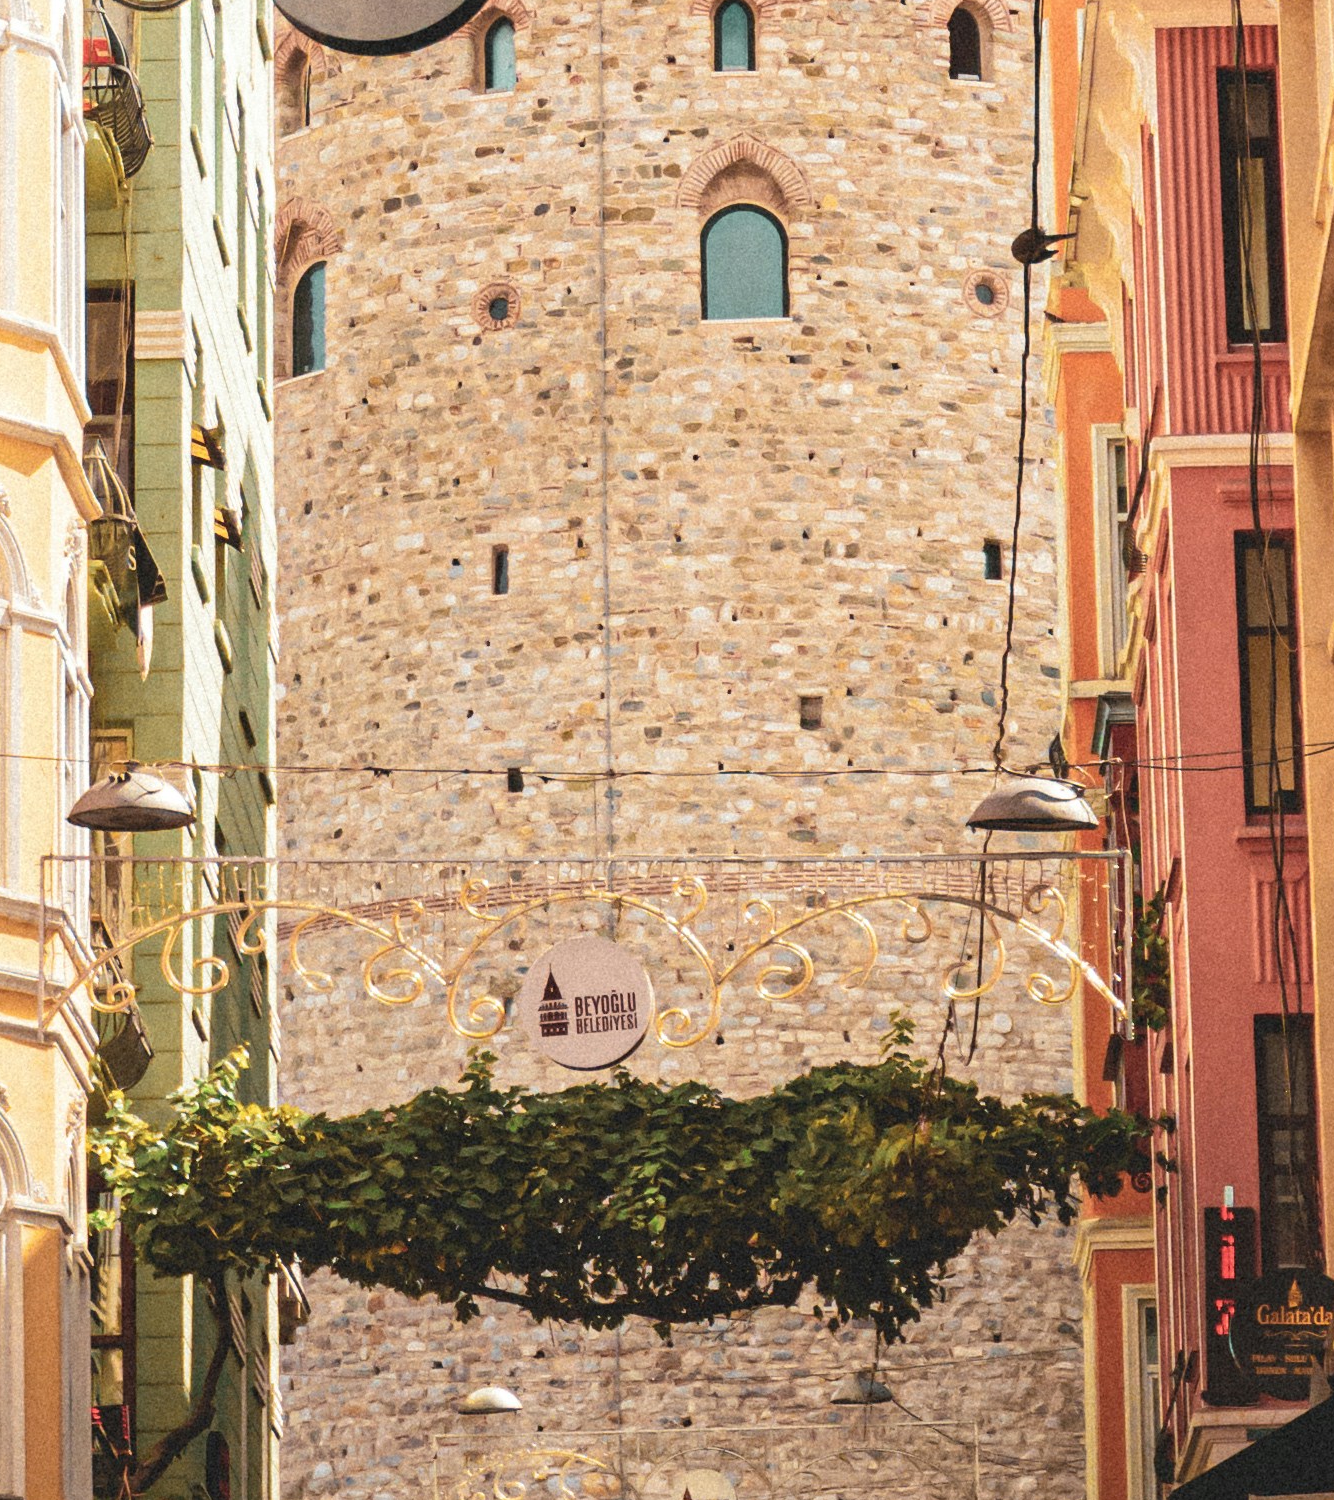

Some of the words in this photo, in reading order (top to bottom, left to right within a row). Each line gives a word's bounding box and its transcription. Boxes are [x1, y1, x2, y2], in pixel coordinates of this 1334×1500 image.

[575, 990, 637, 1017] BEYOĞLU
[576, 1013, 638, 1034] BELEDİYESİ
[1255, 1303, 1334, 1326] Galata'da
